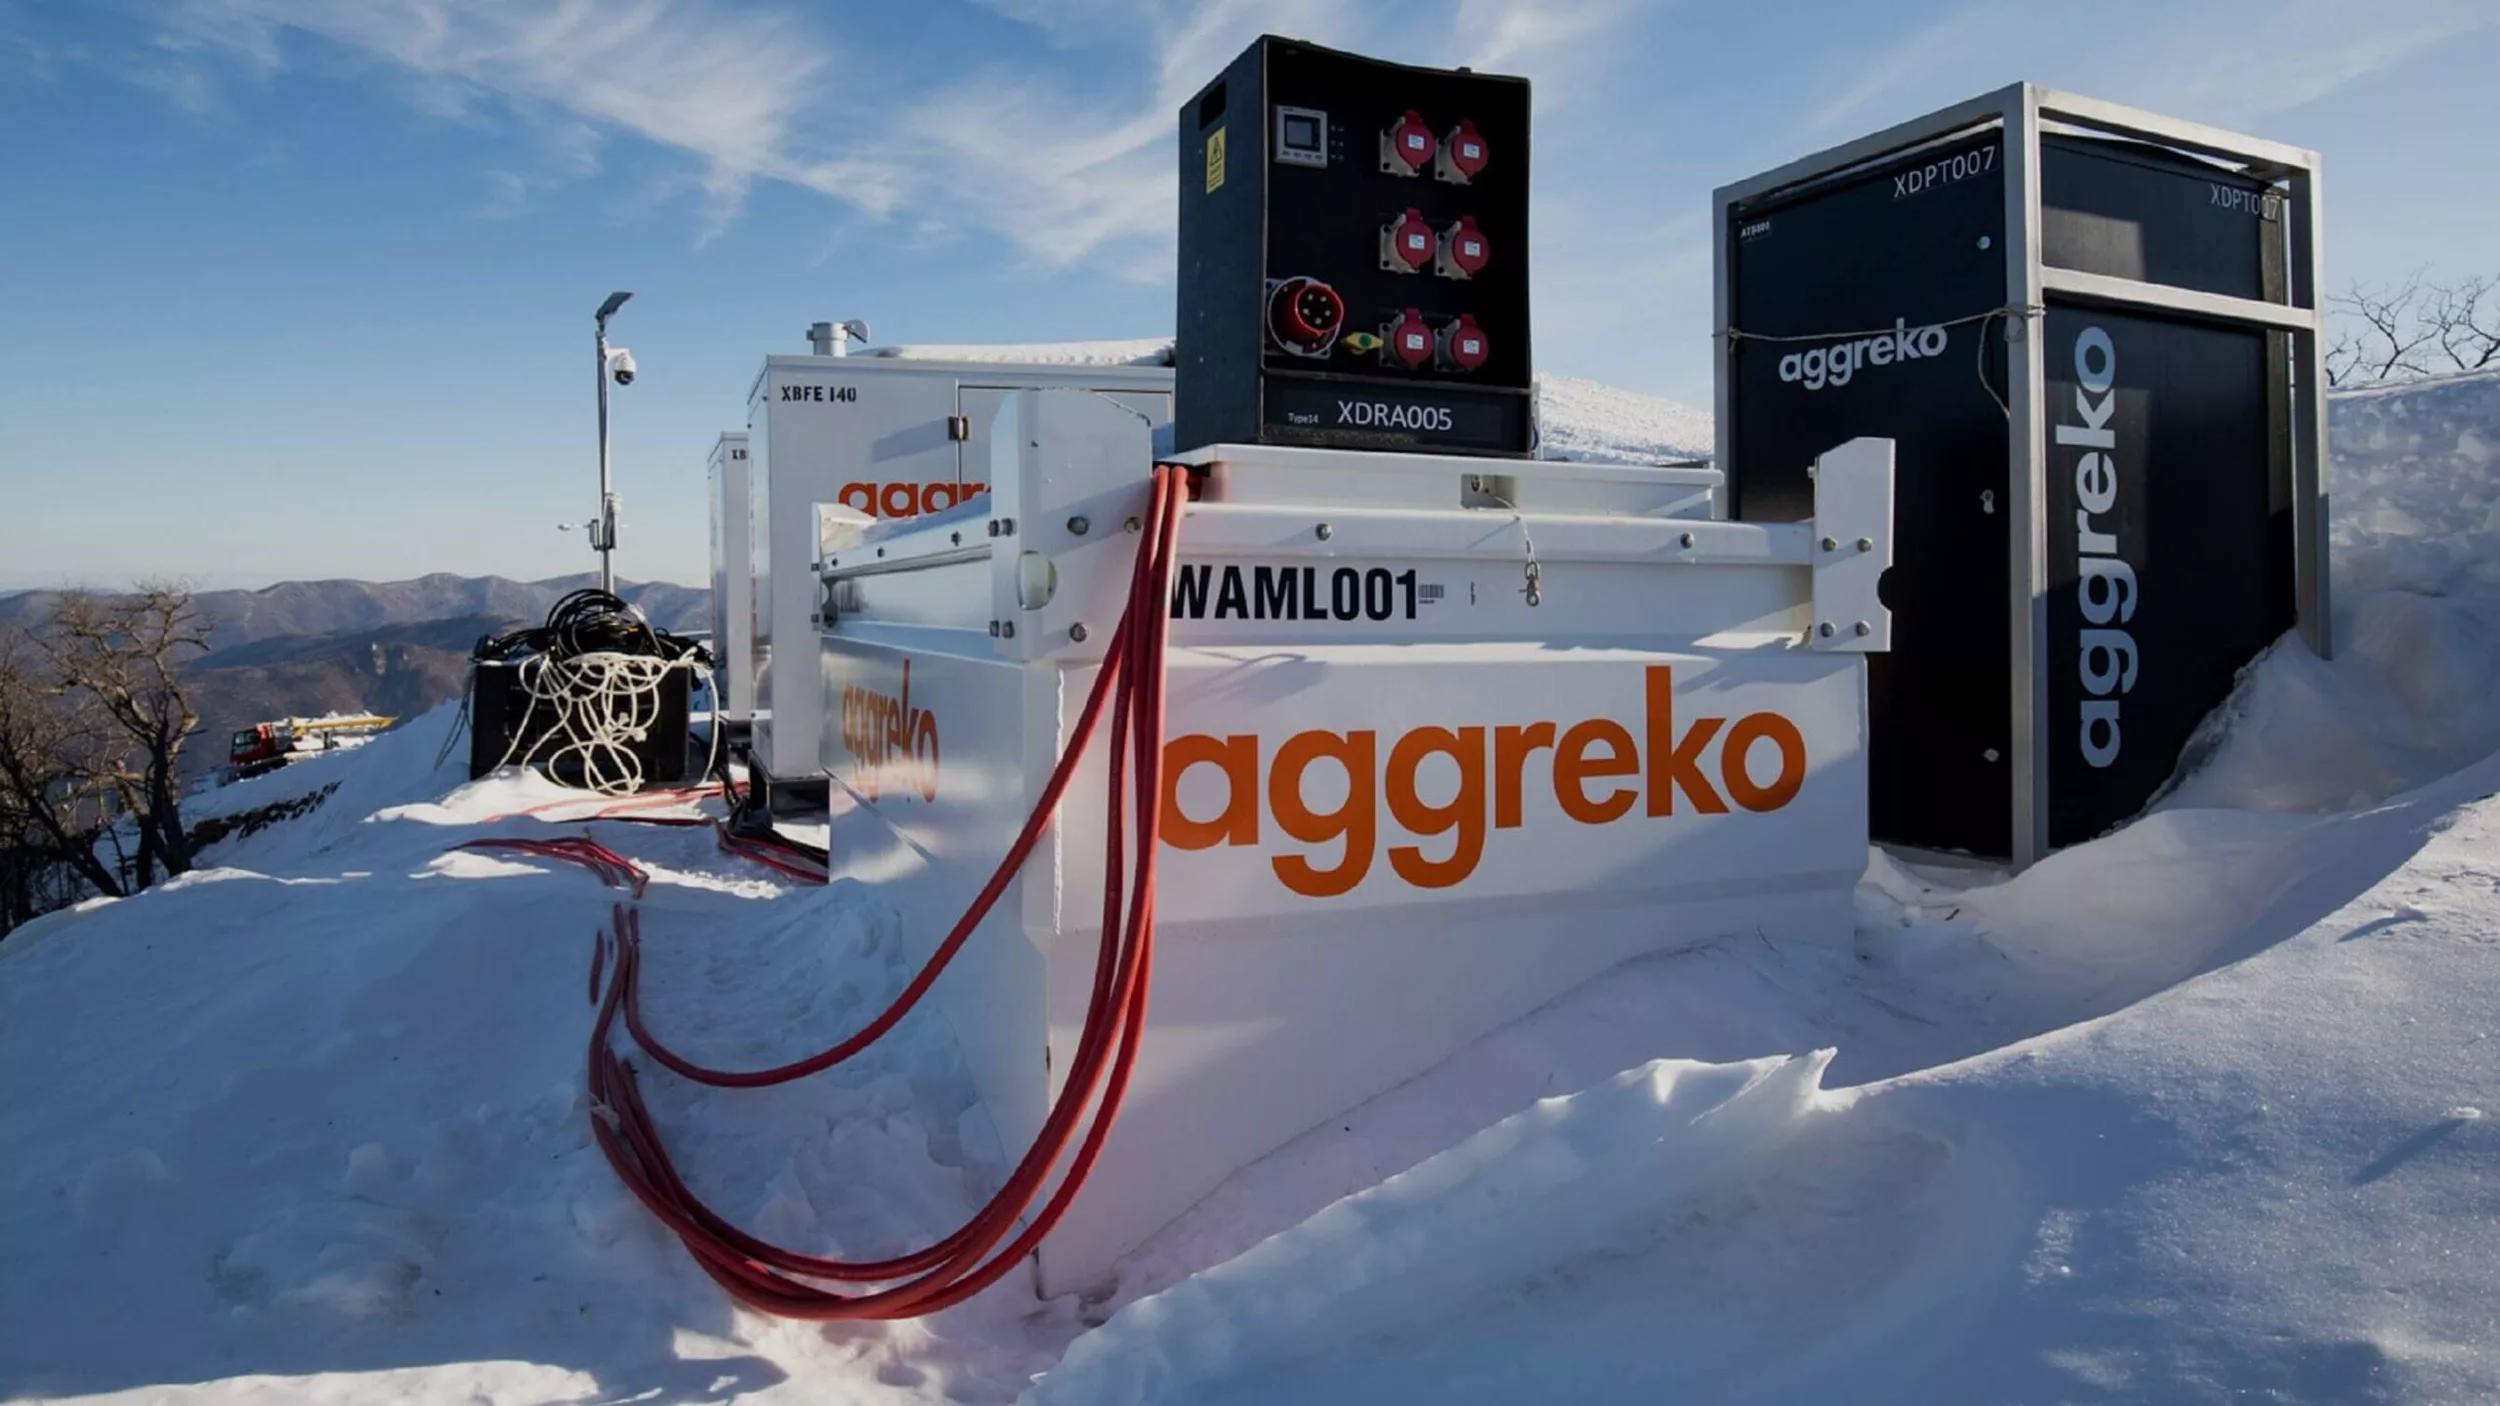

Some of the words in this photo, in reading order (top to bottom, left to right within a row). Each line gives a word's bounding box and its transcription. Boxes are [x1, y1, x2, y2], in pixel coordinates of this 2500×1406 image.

[1893, 145, 1996, 198] XDPT007
[1779, 317, 1948, 390] aggreko
[781, 385, 824, 402] XBFE
[829, 386, 857, 402] 140
[1337, 400, 1453, 431] XDRA005
[2055, 326, 2138, 768] aggreko
[1169, 565, 1416, 621] WAML001
[1157, 665, 1807, 898] aggreko
